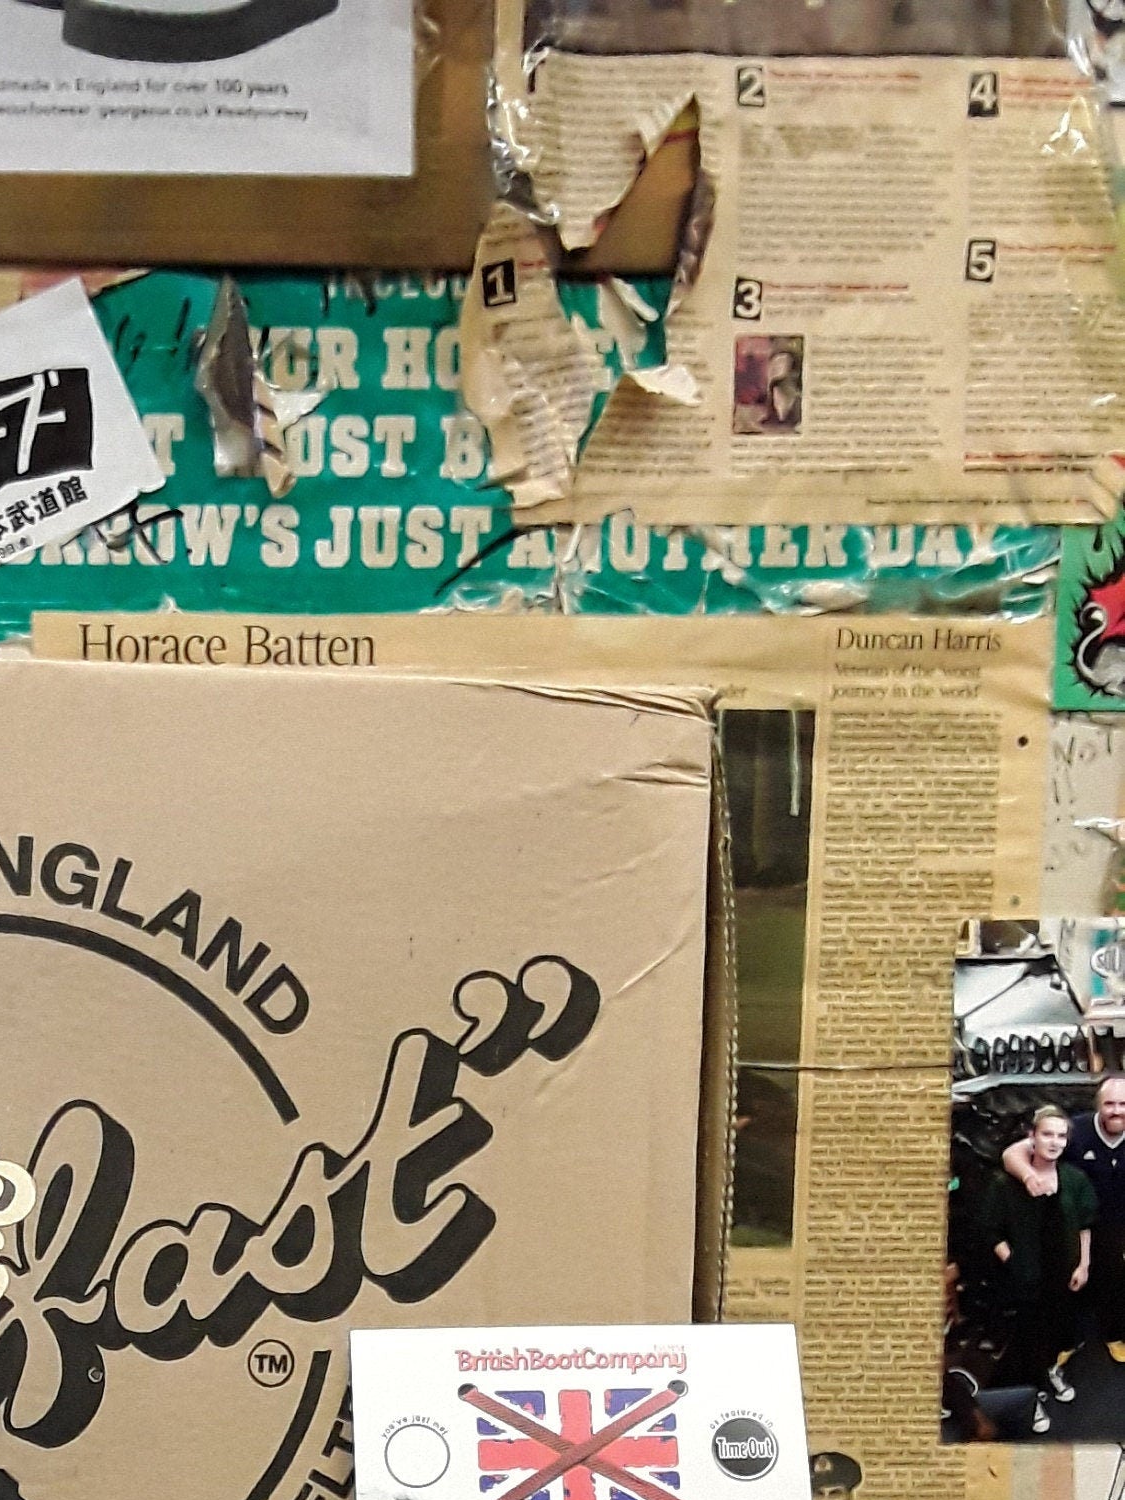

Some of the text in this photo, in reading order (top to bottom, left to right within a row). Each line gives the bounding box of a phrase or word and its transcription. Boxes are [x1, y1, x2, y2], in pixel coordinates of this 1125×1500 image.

[76, 78, 140, 96] England
[215, 79, 242, 93] 100
[740, 68, 765, 105] 2
[970, 72, 997, 110] 4
[969, 242, 993, 280] 5
[486, 265, 516, 306] 1
[736, 280, 762, 318] 3
[315, 505, 493, 568] JUST
[78, 622, 377, 668] Horace Batten
[836, 626, 1002, 652] Duncan Harris
[254, 1353, 289, 1375] TM
[721, 1409, 763, 1421] featured
